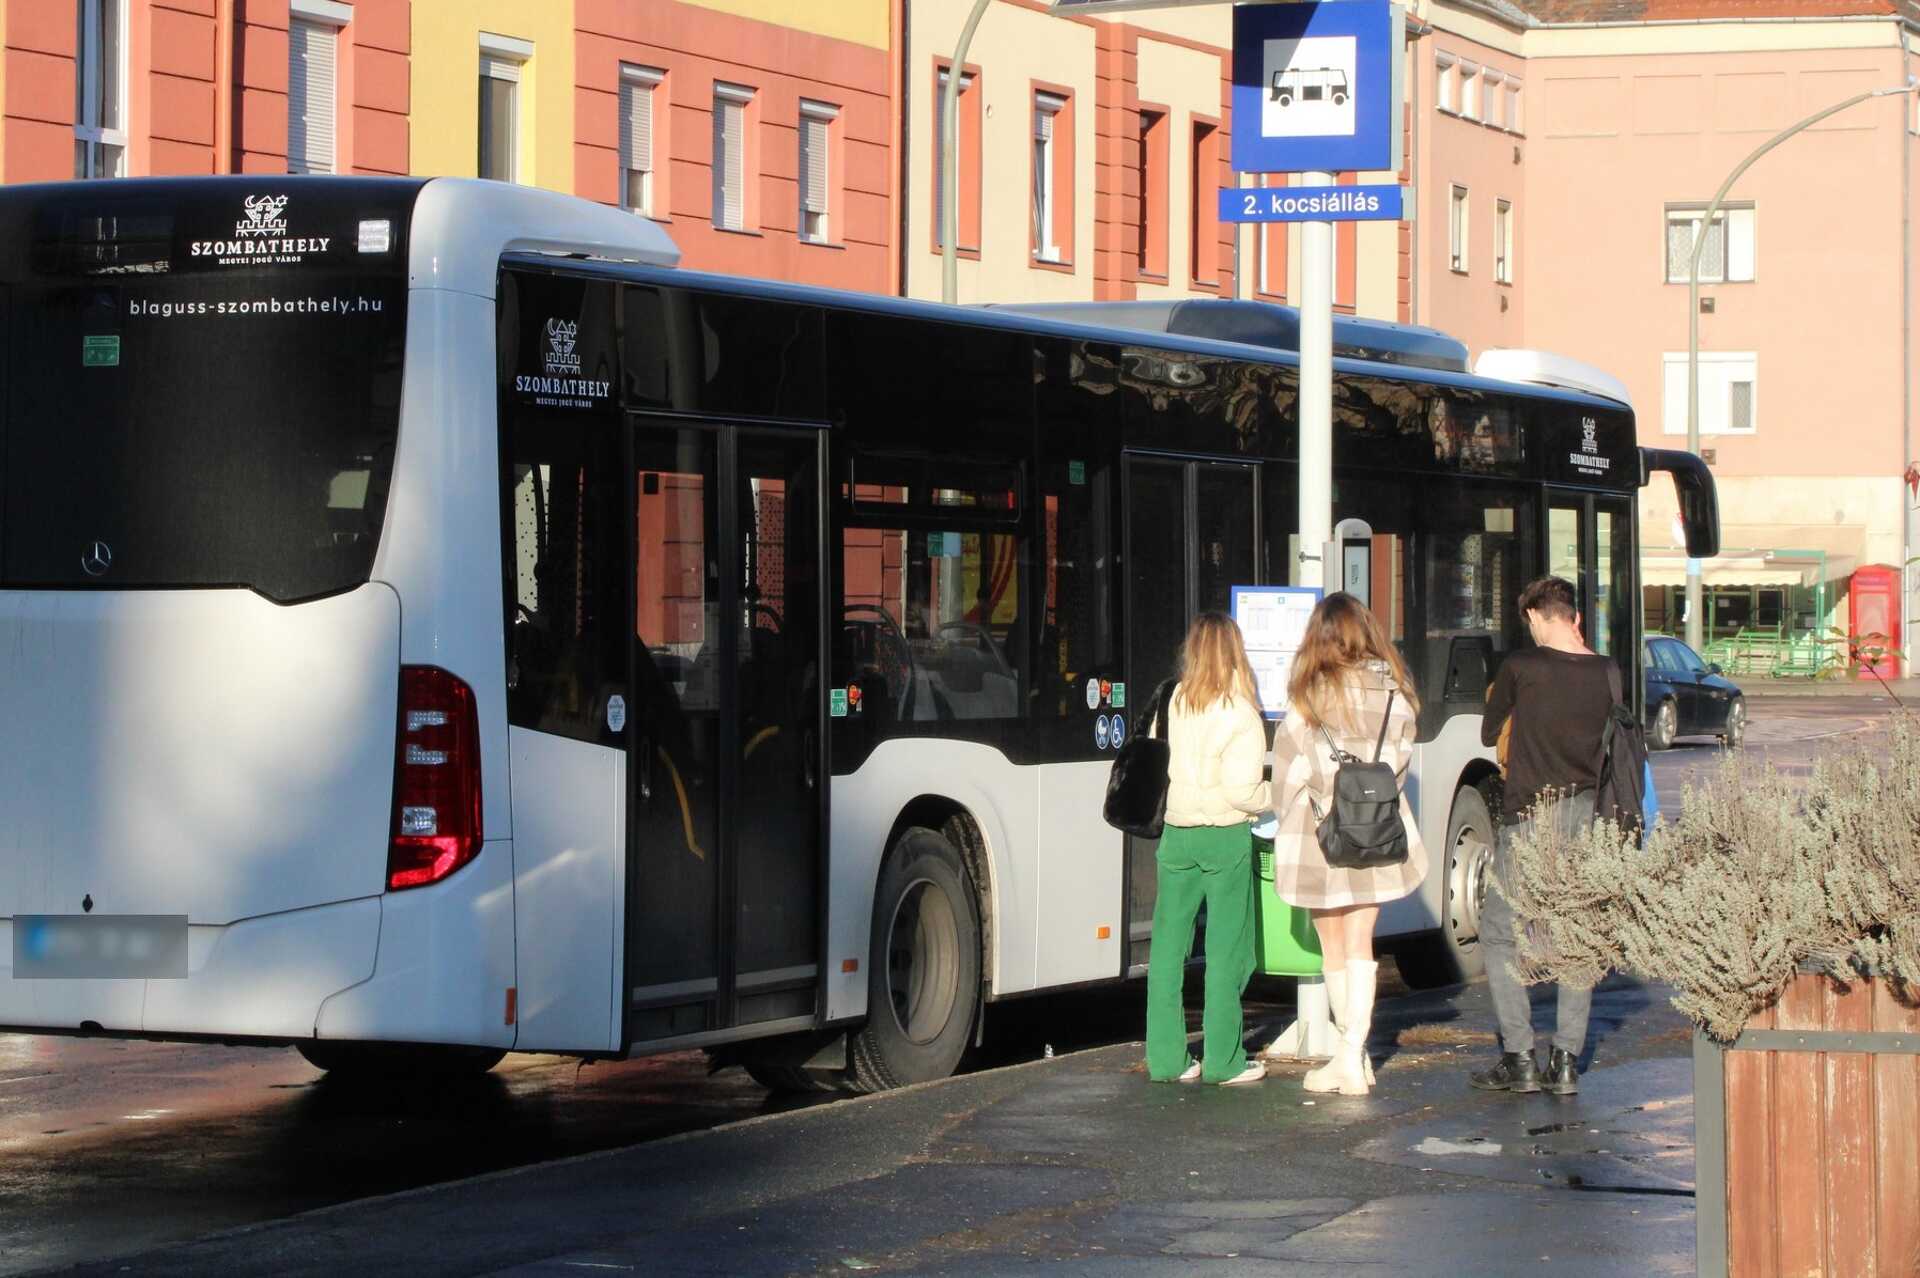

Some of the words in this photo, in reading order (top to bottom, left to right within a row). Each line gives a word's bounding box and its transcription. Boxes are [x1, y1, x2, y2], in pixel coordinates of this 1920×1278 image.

[1243, 195, 1263, 215] 2.
[1271, 192, 1379, 214] kocsiállás
[190, 237, 330, 256] SZOMBATHELY
[218, 257, 250, 265] MEGYEI
[275, 254, 302, 263] VÁROS
[129, 296, 383, 317] blaguss-szombathely.hu
[516, 375, 610, 398] SZOMBATHELY
